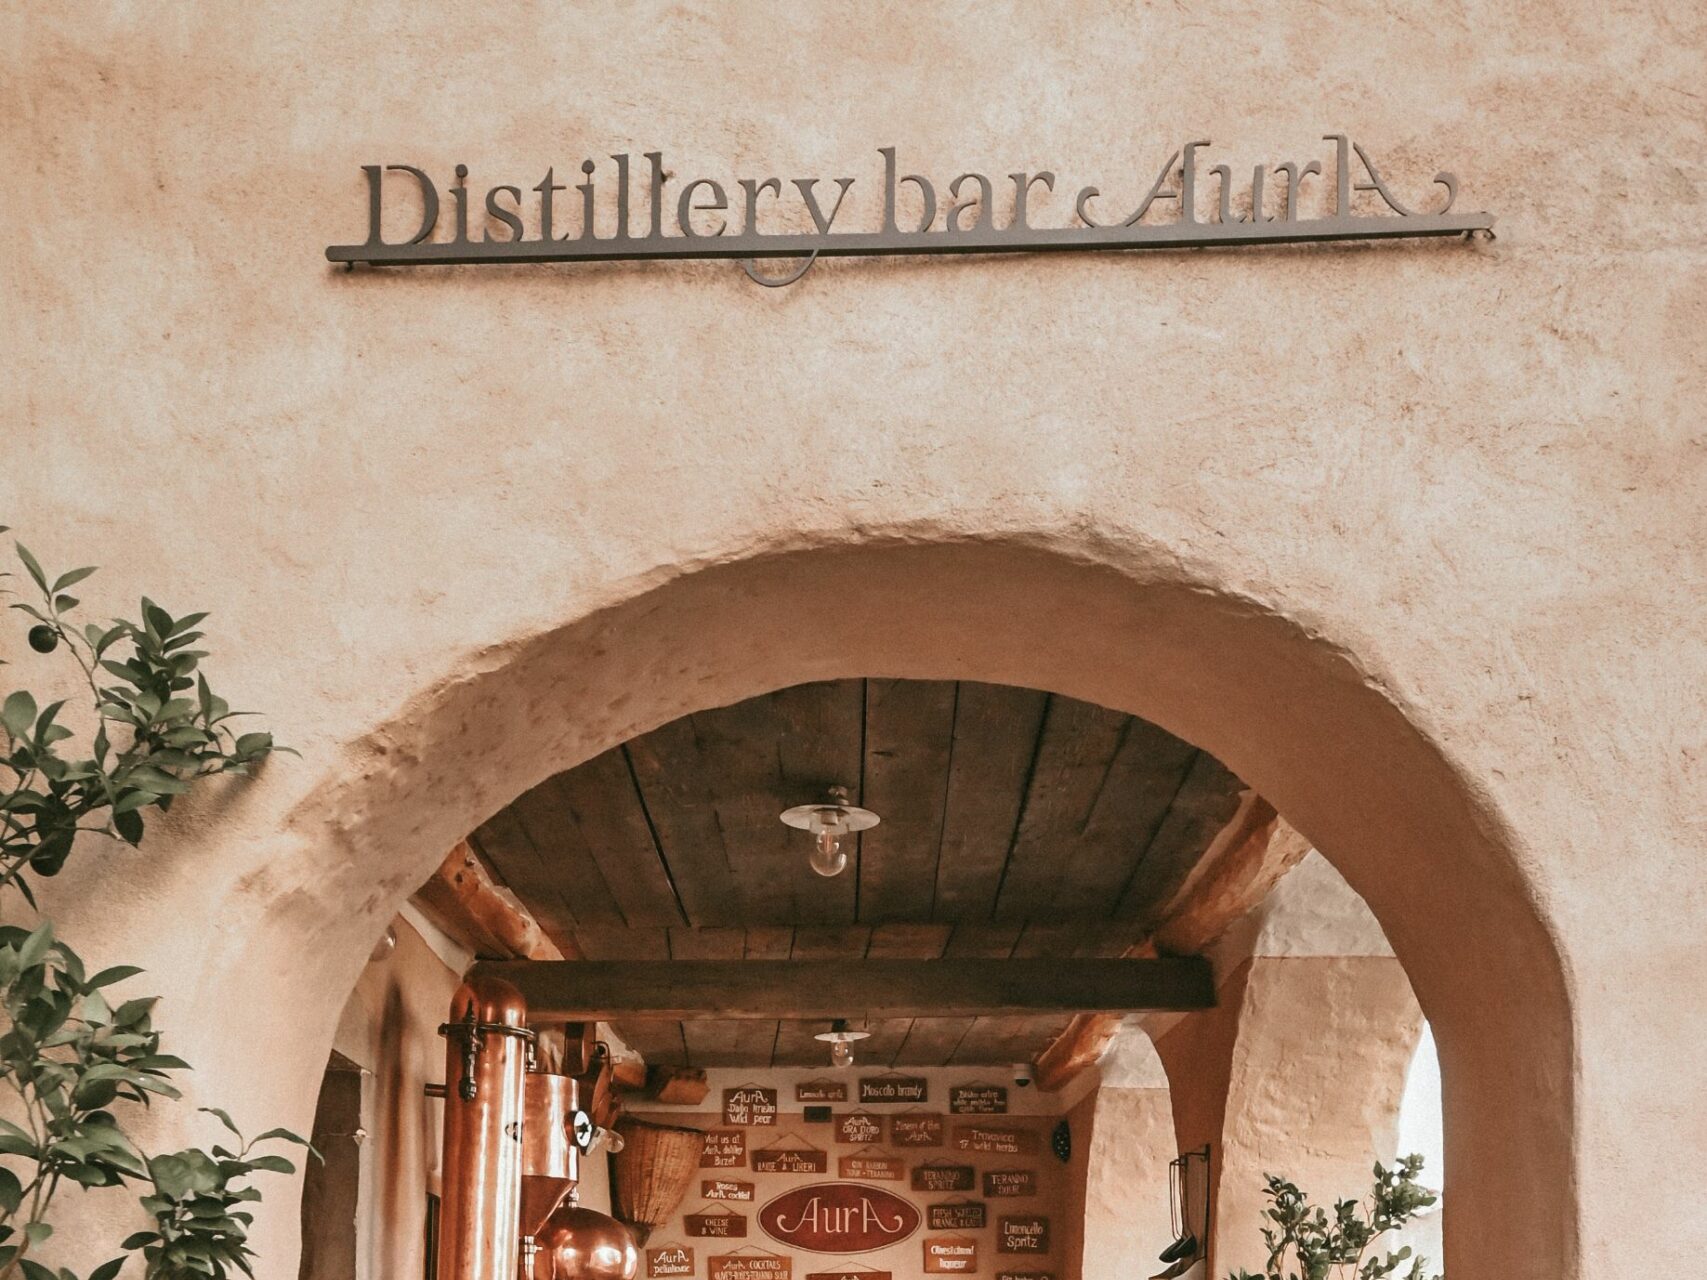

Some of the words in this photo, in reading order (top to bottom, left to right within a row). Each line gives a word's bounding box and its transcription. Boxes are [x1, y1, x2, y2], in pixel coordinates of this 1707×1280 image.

[361, 151, 855, 287] Distillery
[877, 147, 1056, 233] bar
[753, 1115, 772, 1126] pear
[720, 1136, 730, 1144] us
[732, 1134, 741, 1144] at
[705, 1218, 729, 1227] CHEESE
[709, 1227, 728, 1236] WINE
